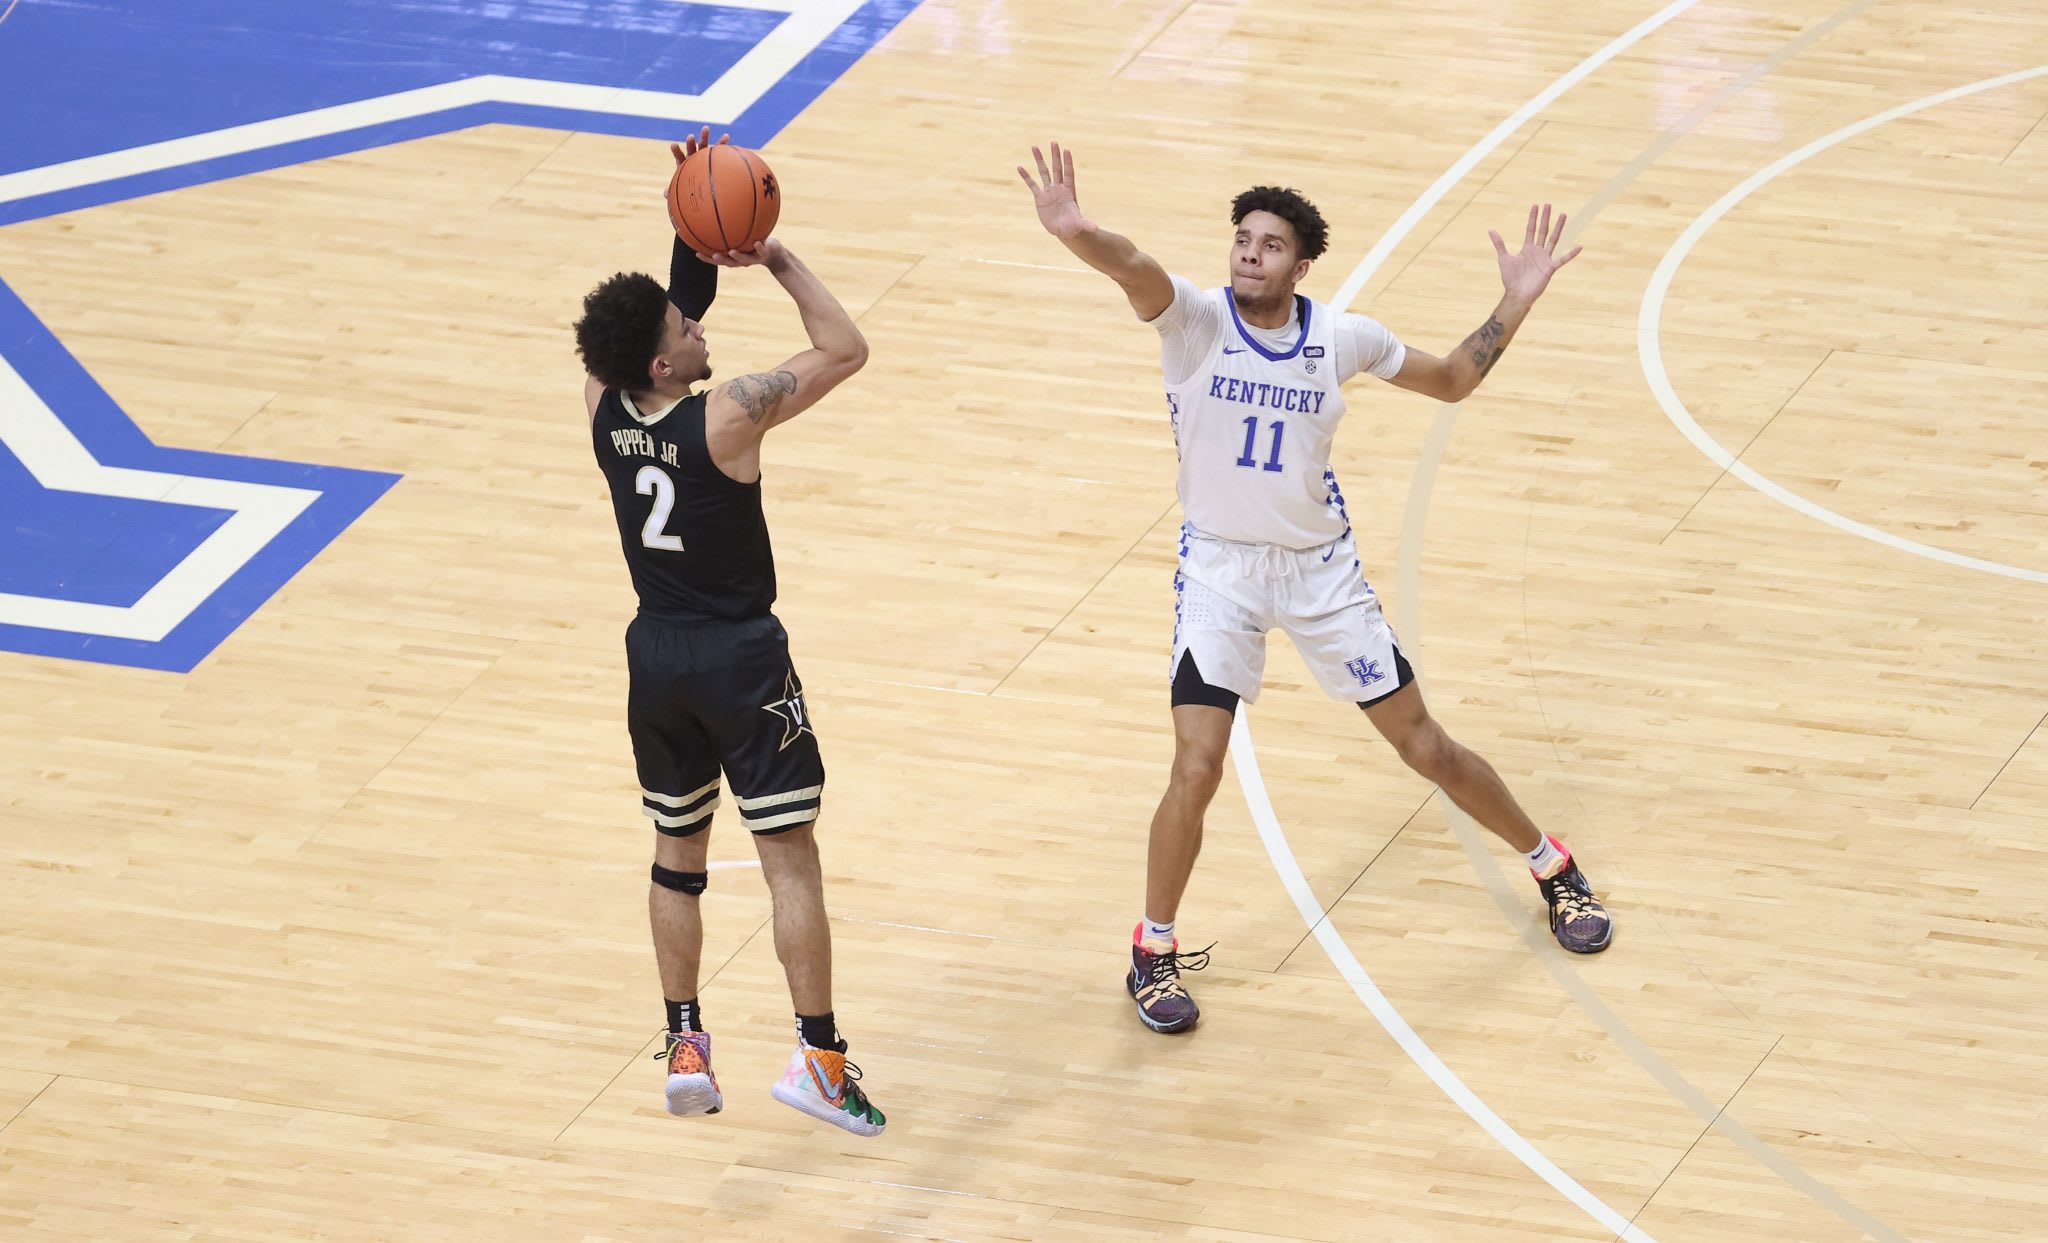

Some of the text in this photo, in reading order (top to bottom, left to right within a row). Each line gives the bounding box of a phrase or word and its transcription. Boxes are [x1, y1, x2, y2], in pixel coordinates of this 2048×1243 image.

[1209, 375, 1325, 413] KENTUCKY
[610, 428, 681, 469] PIPPEN JR.
[1236, 416, 1285, 473] 11
[635, 465, 685, 552] 2
[787, 698, 803, 726] V
